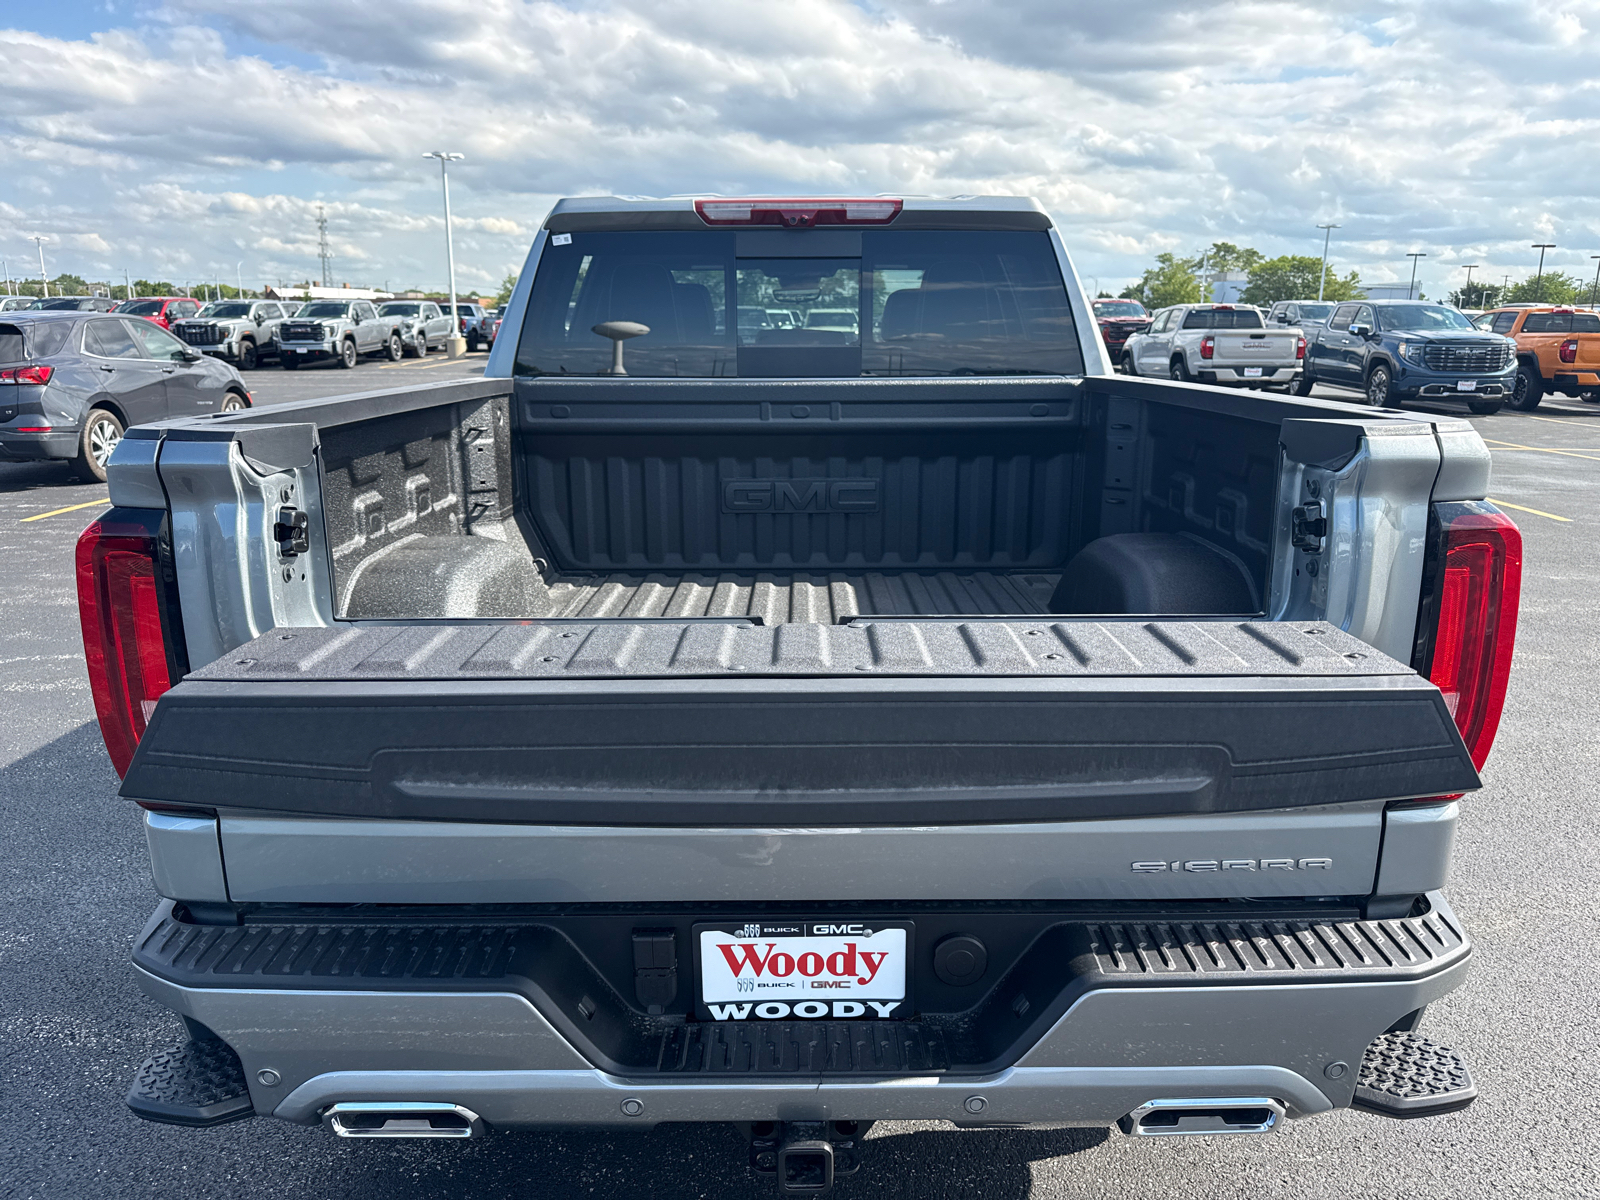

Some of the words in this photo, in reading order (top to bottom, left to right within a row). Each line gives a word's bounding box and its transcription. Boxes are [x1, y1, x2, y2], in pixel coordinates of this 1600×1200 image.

[725, 482, 876, 510] GMC
[1130, 857, 1333, 873] SIERRA
[813, 924, 863, 935] GMC
[716, 943, 889, 986] Woody
[811, 980, 851, 989] GMC
[707, 1001, 901, 1021] WOODY
